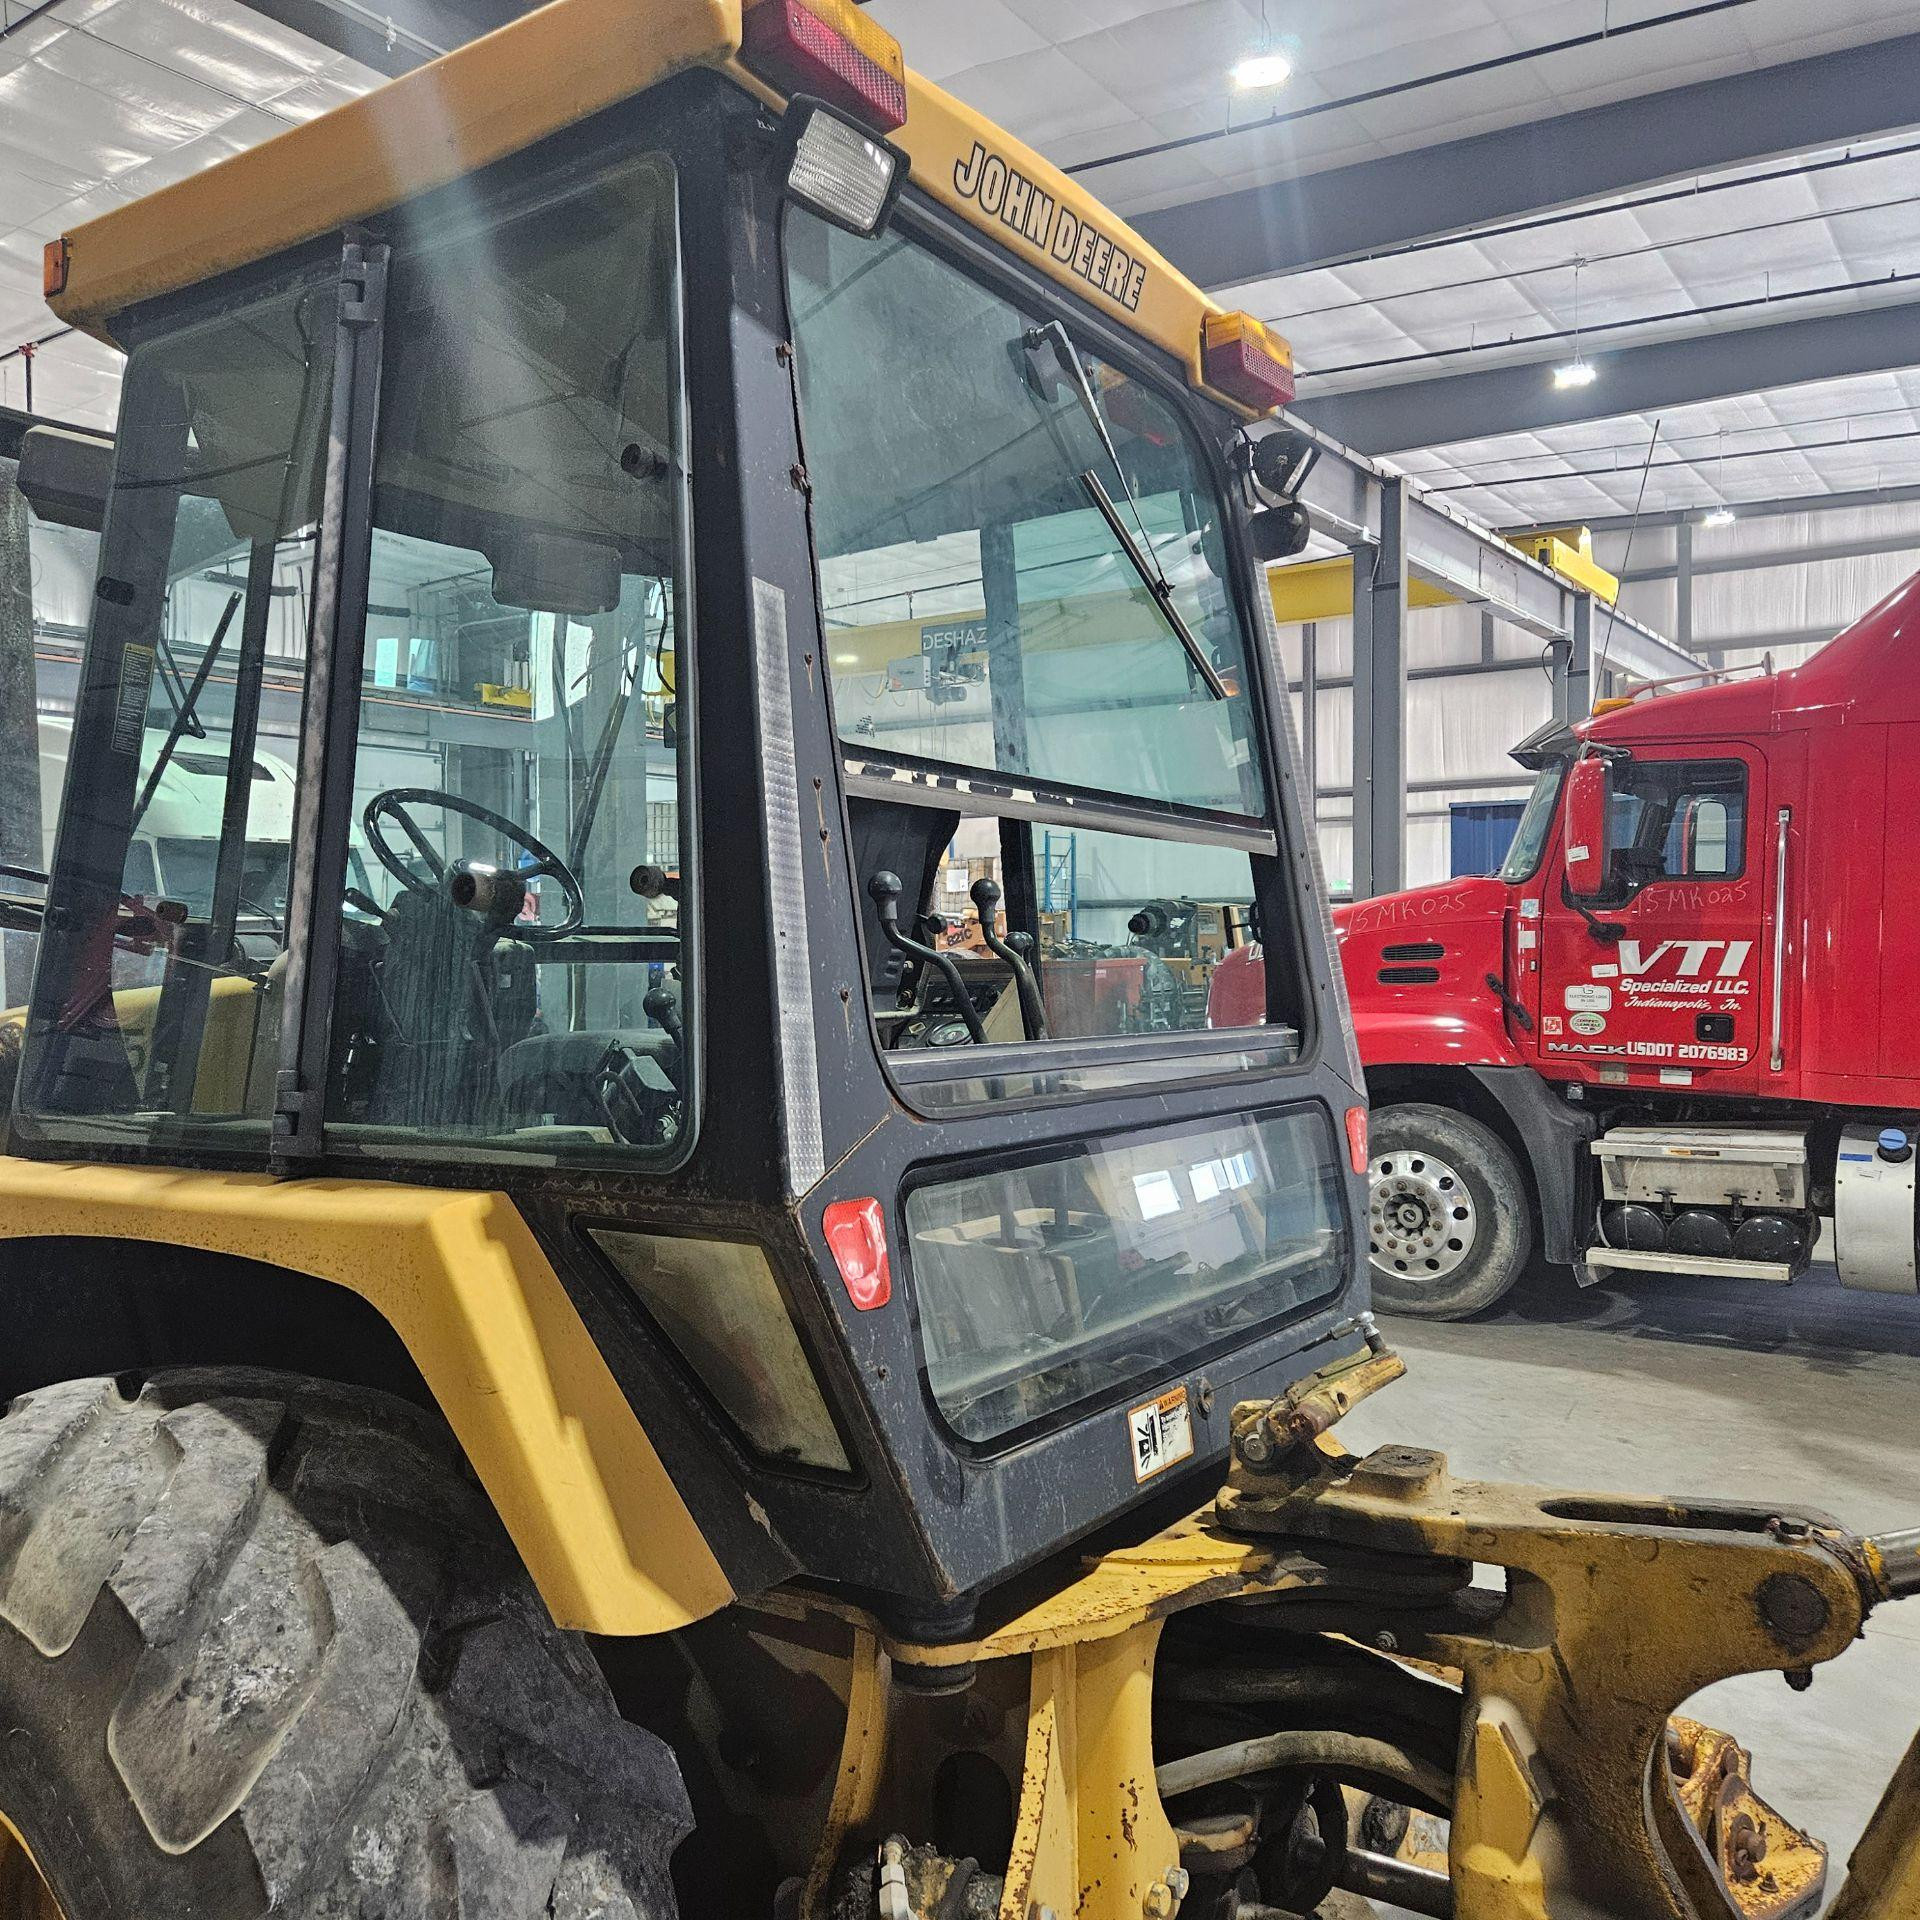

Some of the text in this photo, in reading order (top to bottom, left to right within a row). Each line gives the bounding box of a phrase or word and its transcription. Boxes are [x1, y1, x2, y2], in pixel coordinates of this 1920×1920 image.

[954, 141, 1147, 313] JOHN DEERE
[1618, 940, 1753, 976] VTI
[1619, 978, 1750, 995] Specialized LLC.
[1624, 996, 1712, 1013] Indianapolis,
[1548, 1042, 1627, 1056] MACK
[1627, 1041, 1749, 1062] USDOT 2076983
